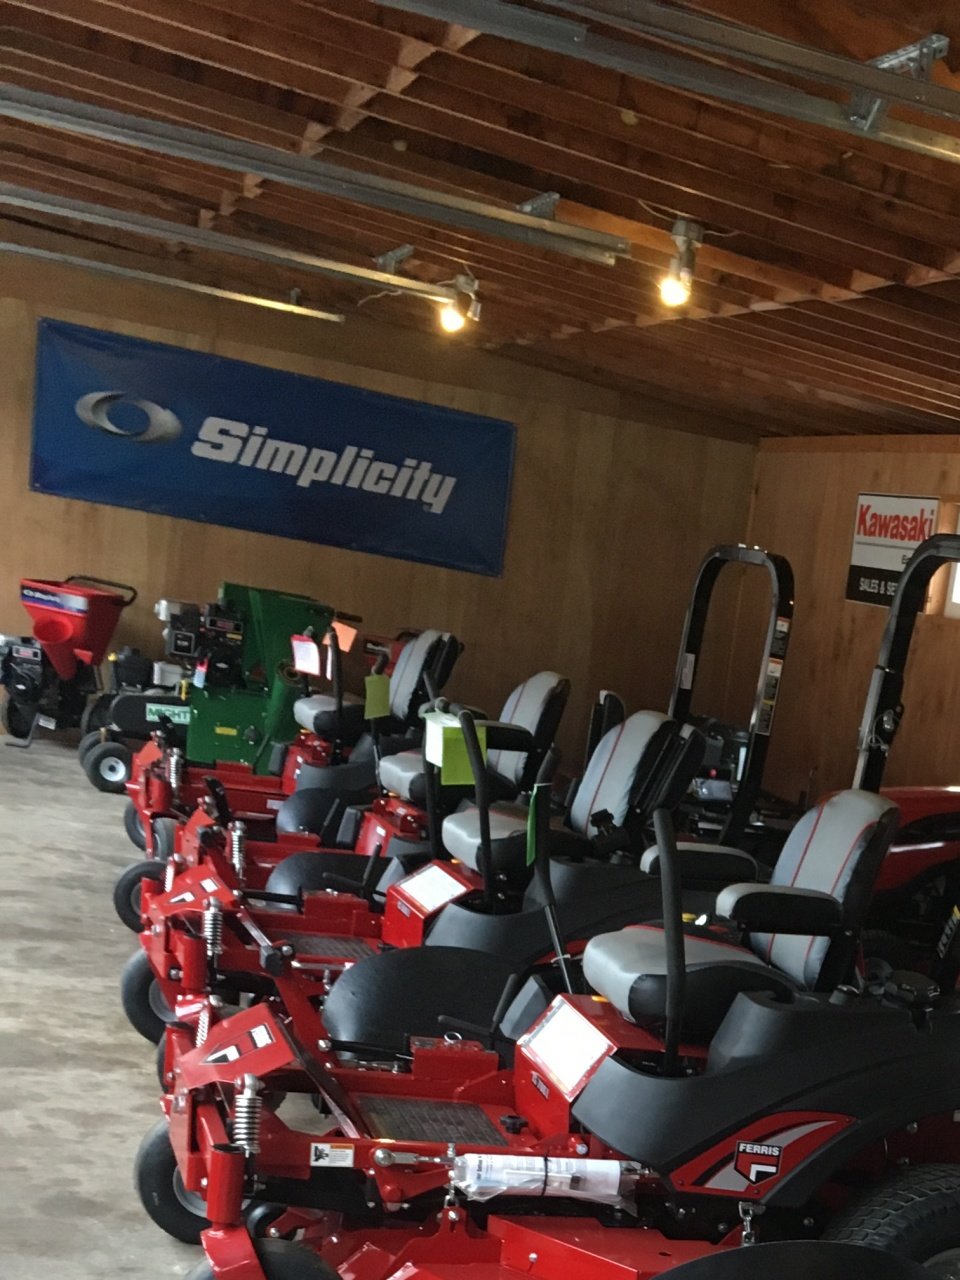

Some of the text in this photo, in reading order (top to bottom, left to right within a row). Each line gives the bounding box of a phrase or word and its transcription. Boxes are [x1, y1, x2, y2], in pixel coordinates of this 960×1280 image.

[190, 416, 457, 514] Simplicity
[857, 504, 935, 542] Kawasaki
[859, 577, 880, 594] SALES
[739, 1143, 780, 1157] FERRIS
